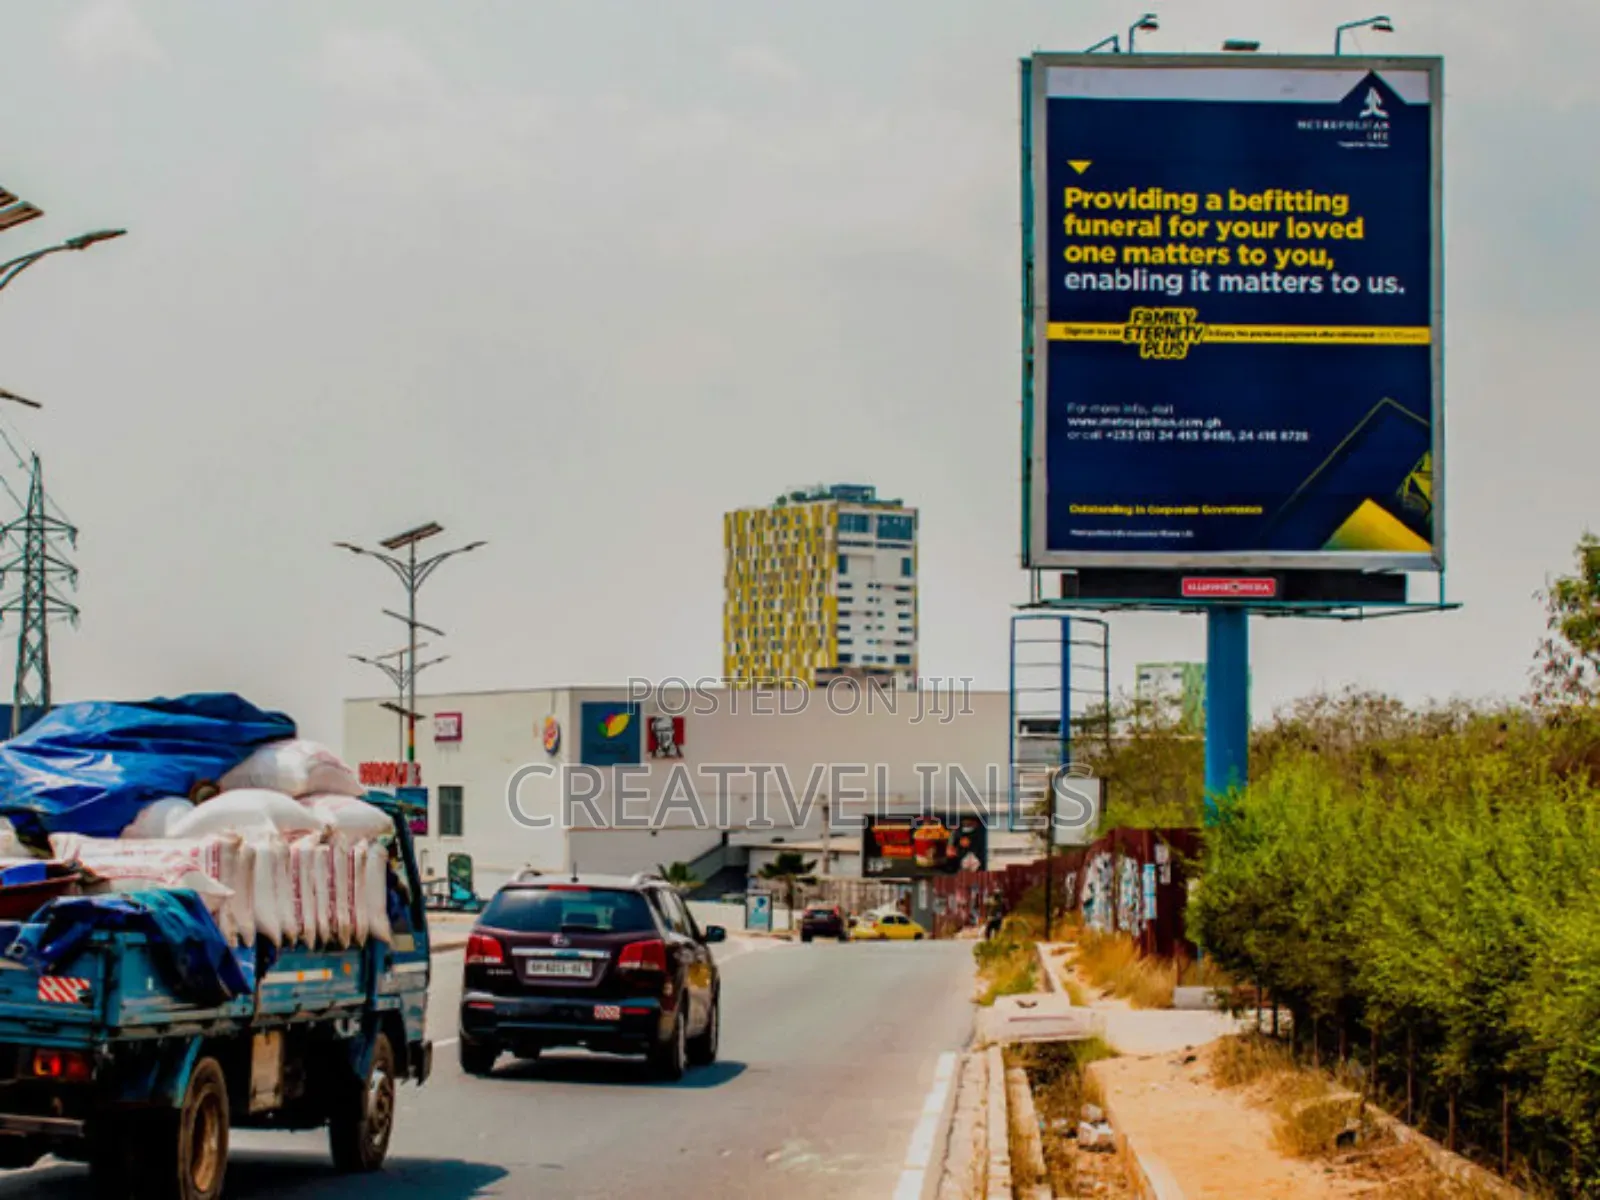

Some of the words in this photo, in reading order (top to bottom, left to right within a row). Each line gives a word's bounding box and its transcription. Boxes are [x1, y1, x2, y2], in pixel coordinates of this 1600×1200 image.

[1063, 186, 1199, 215] Providing
[1204, 192, 1223, 211] a
[1228, 187, 1350, 217] befitting
[1063, 213, 1162, 238] funeral
[1167, 214, 1210, 239] for
[1215, 219, 1281, 243] your
[1285, 215, 1365, 240] loved
[1063, 244, 1117, 264] one
[1122, 242, 1231, 266] matters
[1236, 243, 1268, 267] to
[1273, 247, 1335, 271] you,
[1063, 267, 1184, 297] enabling
[1190, 268, 1211, 293] it
[1218, 271, 1324, 294] matters
[1331, 272, 1361, 294] to
[1367, 275, 1406, 295] us.
[1132, 309, 1196, 325] FAMILY
[1122, 325, 1205, 341] ETERNITY
[1144, 341, 1186, 357] PLUS
